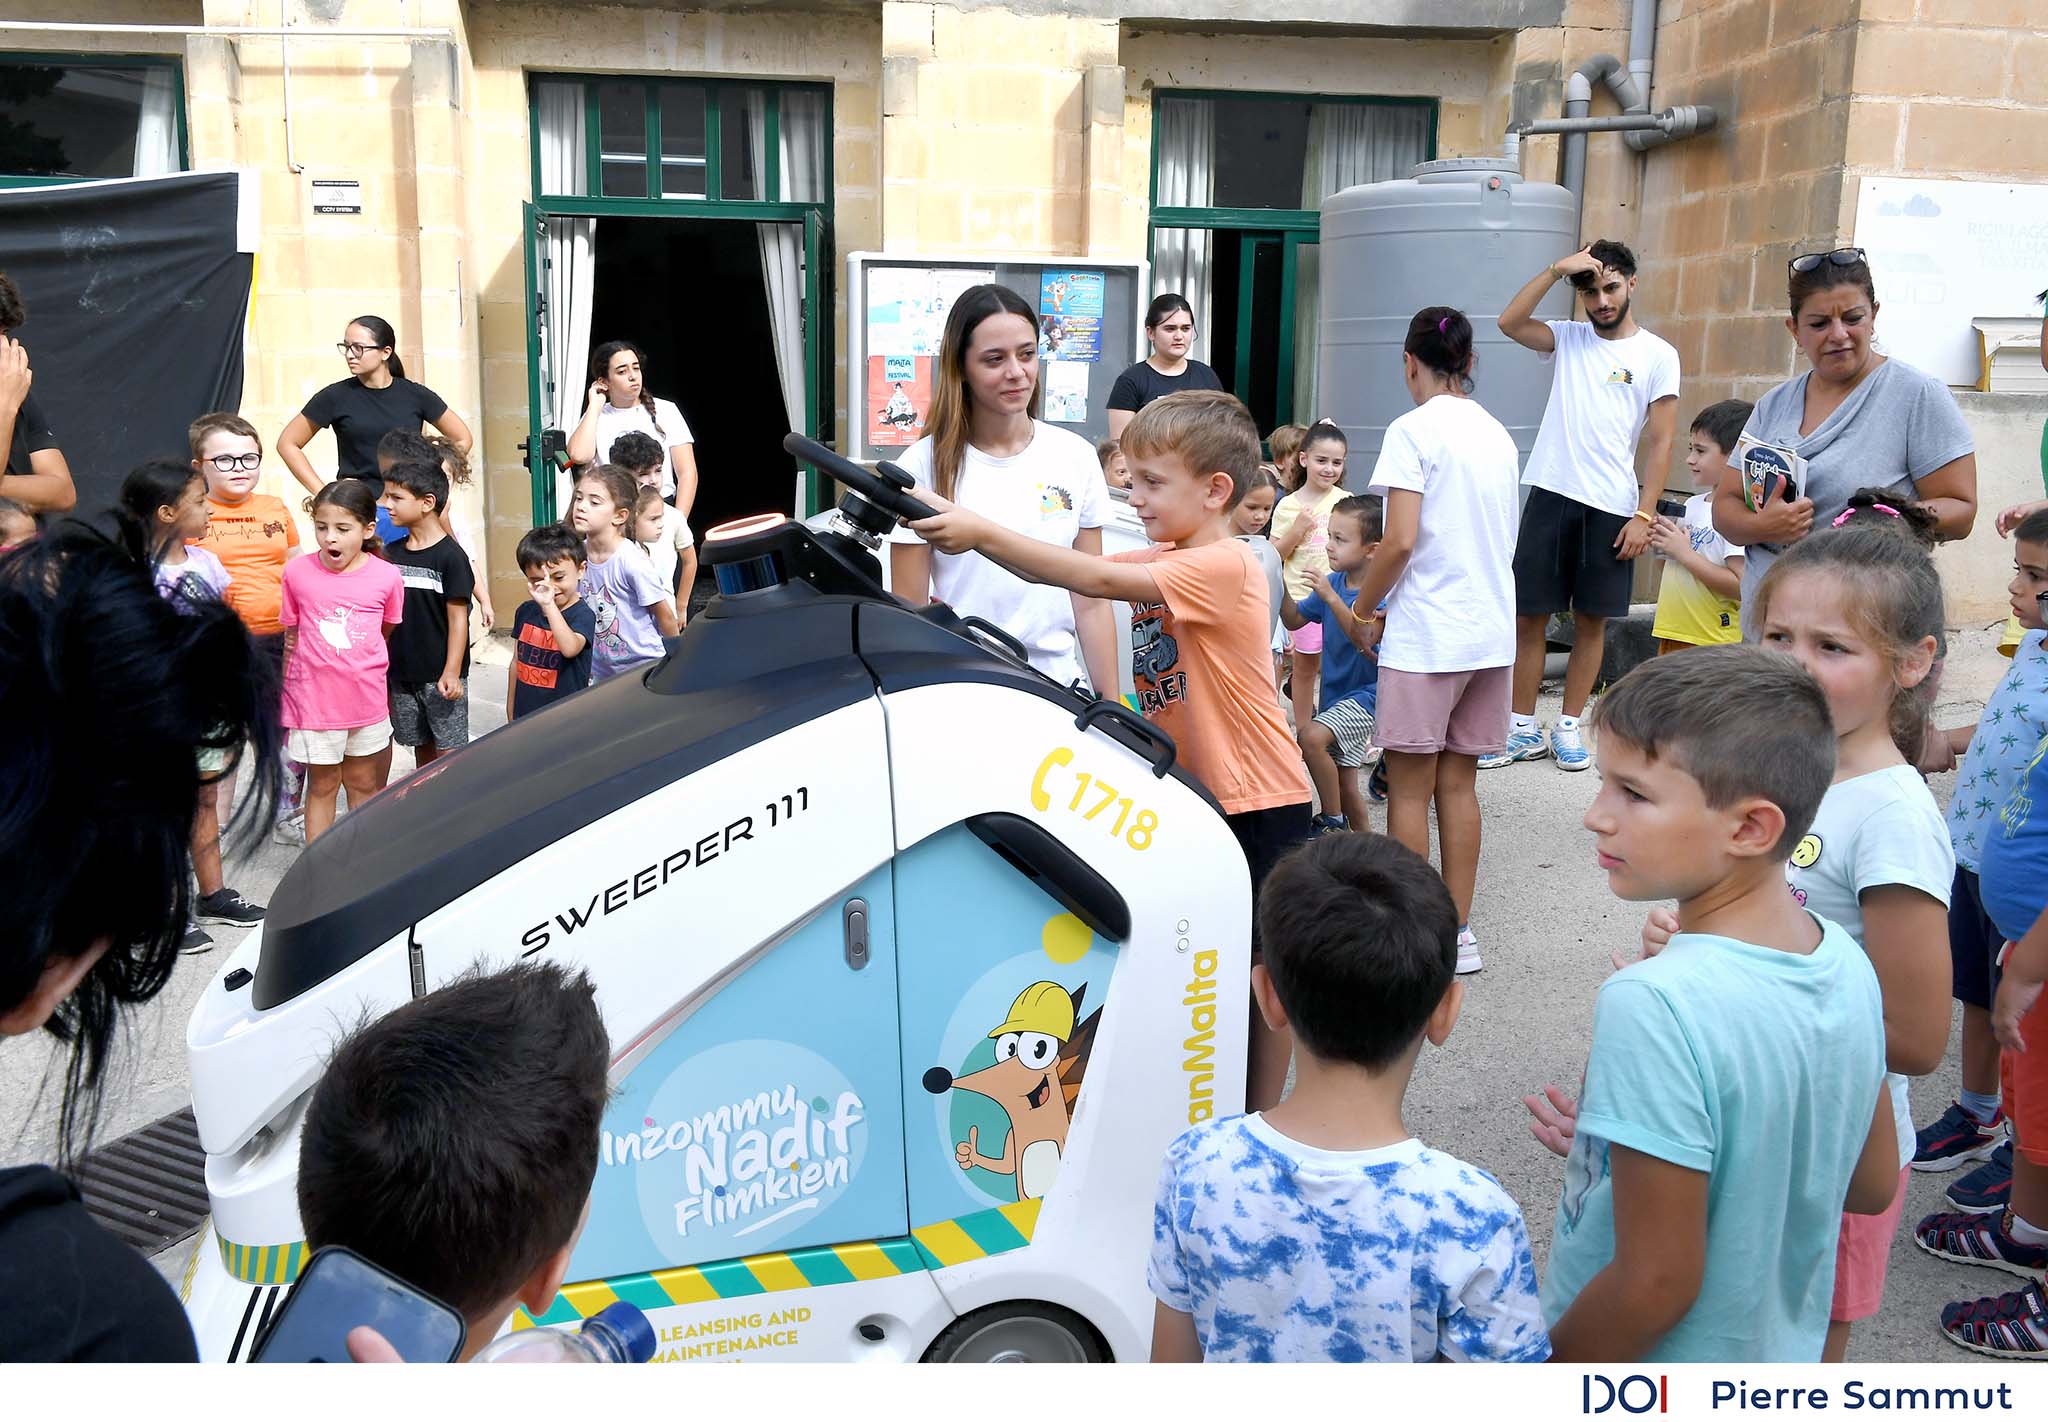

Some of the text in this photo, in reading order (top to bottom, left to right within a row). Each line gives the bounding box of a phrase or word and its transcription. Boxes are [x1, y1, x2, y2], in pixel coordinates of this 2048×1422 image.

[888, 359, 912, 367] MALTA
[517, 666, 550, 686] OSS
[528, 646, 560, 669] BIG
[1068, 772, 1159, 851] 1718
[521, 786, 808, 959] SWEEPER 111
[1182, 949, 1218, 1126] anMalta
[685, 1091, 864, 1196] Nadif
[673, 1156, 849, 1236] Flimkien
[660, 1307, 812, 1343] LEANSING AND
